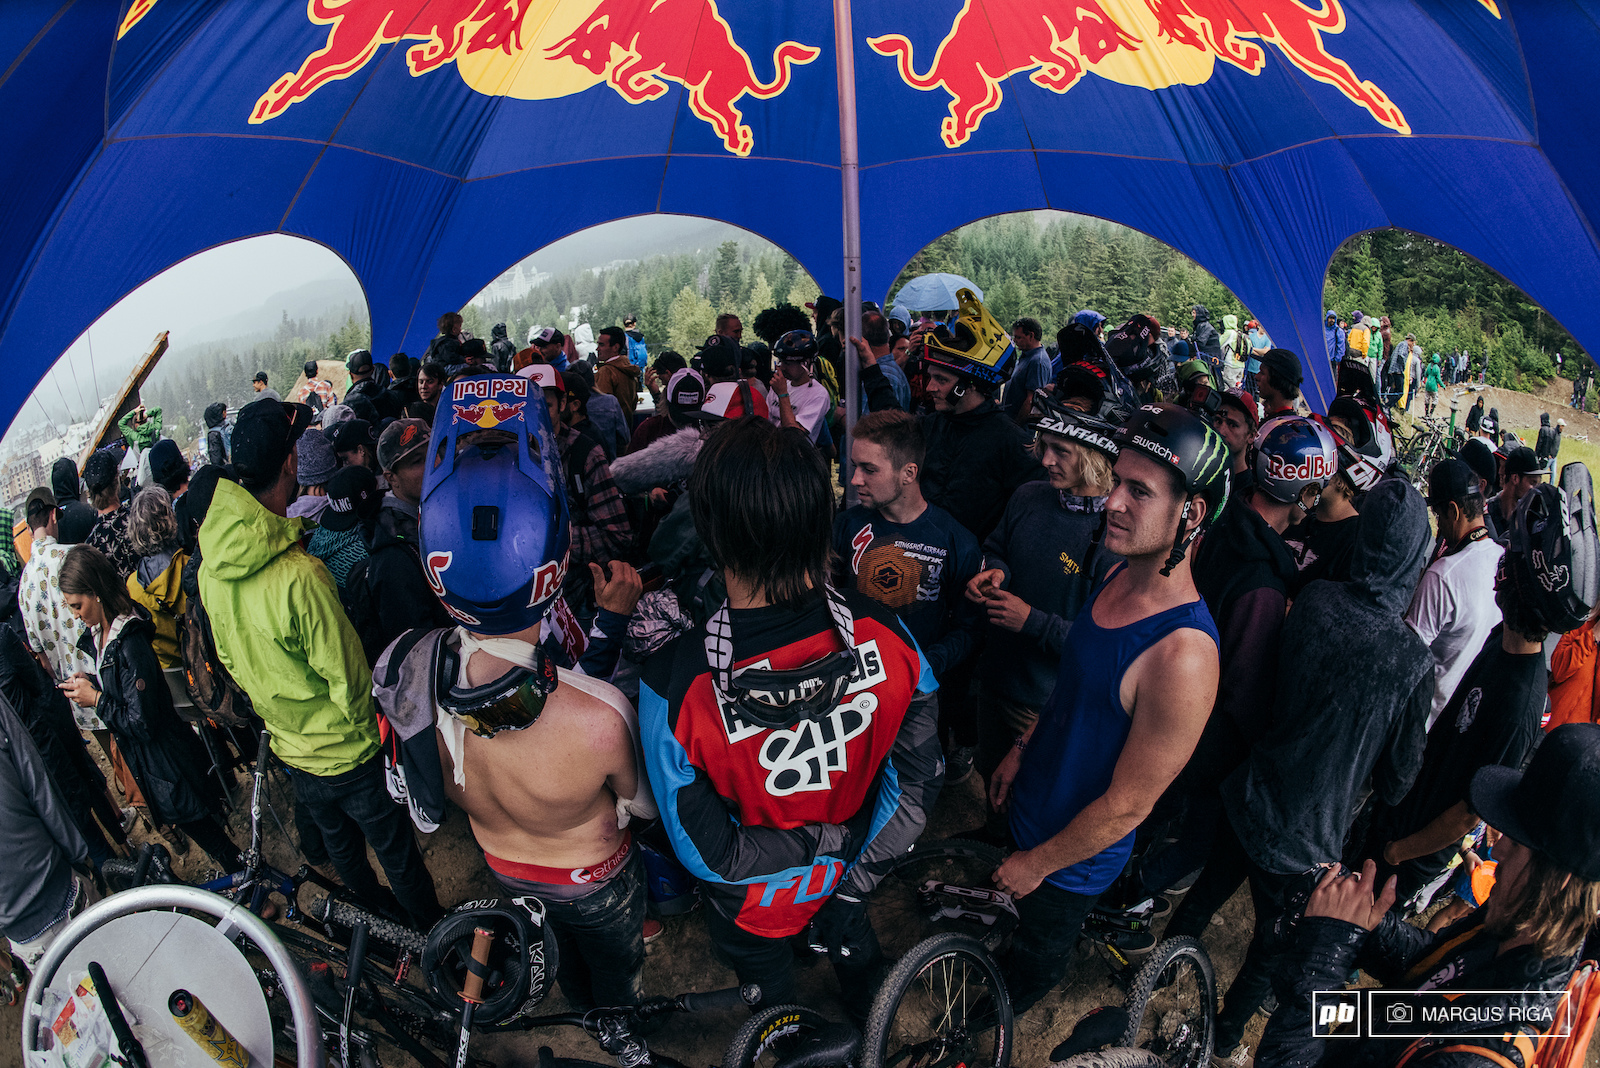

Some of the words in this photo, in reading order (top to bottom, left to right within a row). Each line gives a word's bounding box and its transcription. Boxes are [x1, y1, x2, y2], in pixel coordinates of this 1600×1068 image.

[452, 379, 490, 401] Bull
[491, 378, 529, 399] Red
[1131, 434, 1173, 461] swatch
[1267, 454, 1312, 480] Red
[1311, 449, 1338, 480] Bull
[1557, 486, 1571, 540] FOX
[799, 677, 823, 690] 100%
[760, 1014, 801, 1043] MAXXIS
